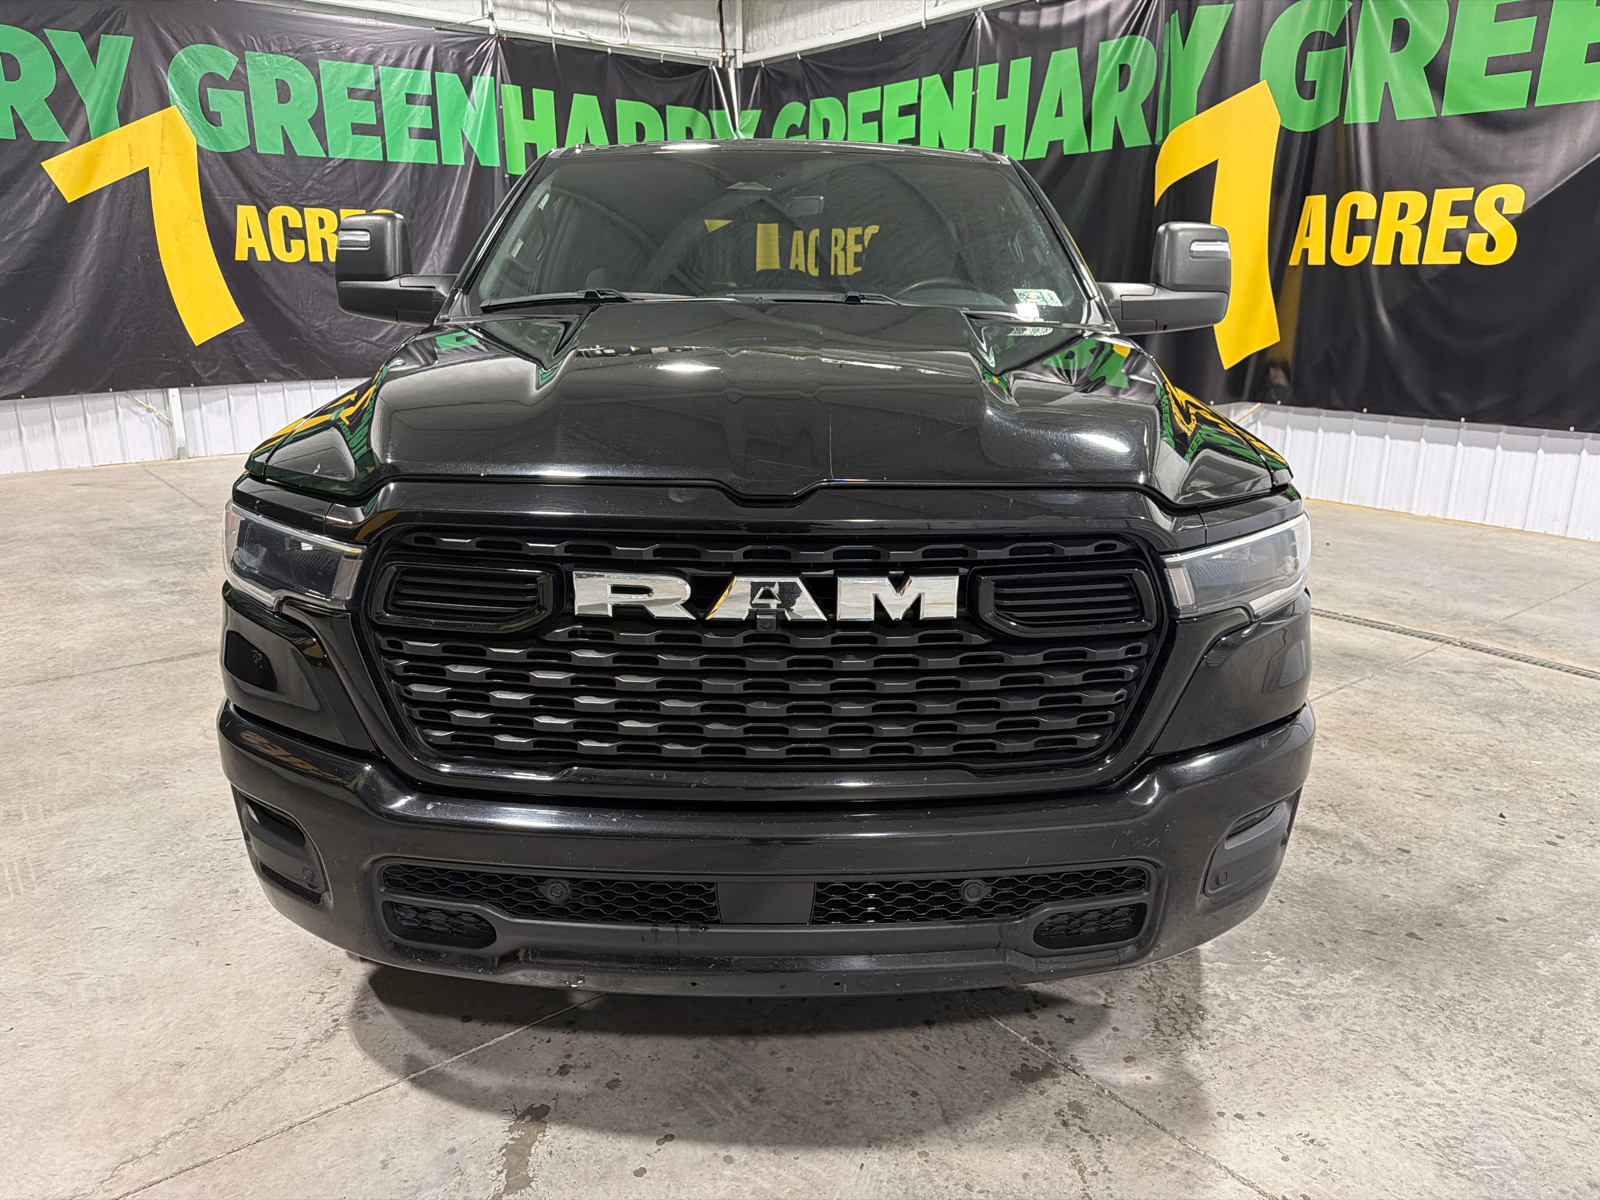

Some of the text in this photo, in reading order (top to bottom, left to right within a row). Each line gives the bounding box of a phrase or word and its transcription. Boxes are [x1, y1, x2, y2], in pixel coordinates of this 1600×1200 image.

[167, 44, 500, 167] GREEN
[41, 105, 395, 346] 7 ACR
[1155, 80, 1525, 370] 7 ACRES
[573, 571, 960, 622] RAM
